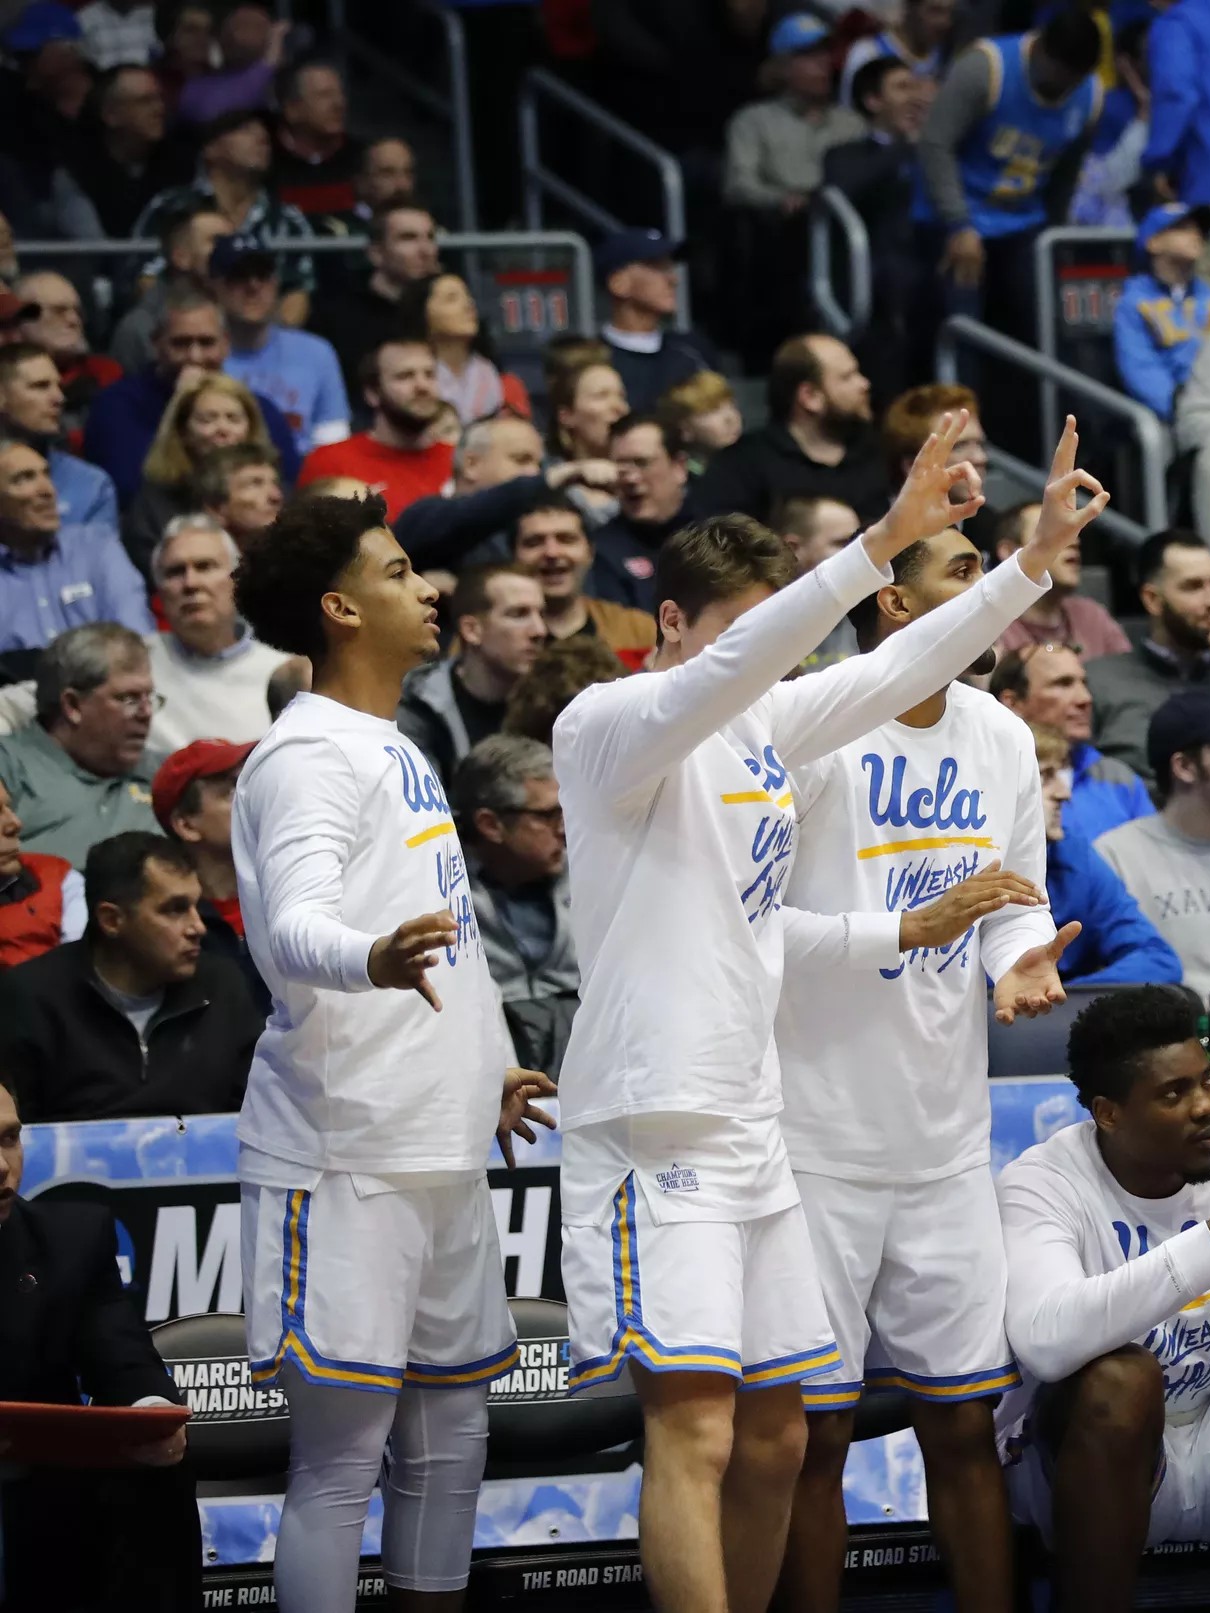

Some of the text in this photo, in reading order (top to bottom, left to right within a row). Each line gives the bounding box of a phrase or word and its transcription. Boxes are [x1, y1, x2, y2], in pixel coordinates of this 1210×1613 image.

[861, 753, 987, 831] Ucla
[885, 850, 979, 913] UNLEASH
[656, 1168, 697, 1183] CHAMPIONS
[518, 1342, 558, 1369] RCH
[173, 1361, 253, 1389] MARCH
[489, 1365, 570, 1395] MADNE
[187, 1387, 291, 1414] MADNES
[863, 1547, 905, 1568] ROAD
[908, 1544, 937, 1564] STA
[522, 1564, 643, 1590] THE ROAD STAR
[202, 1588, 234, 1609] THE
[356, 1577, 388, 1597] HER
